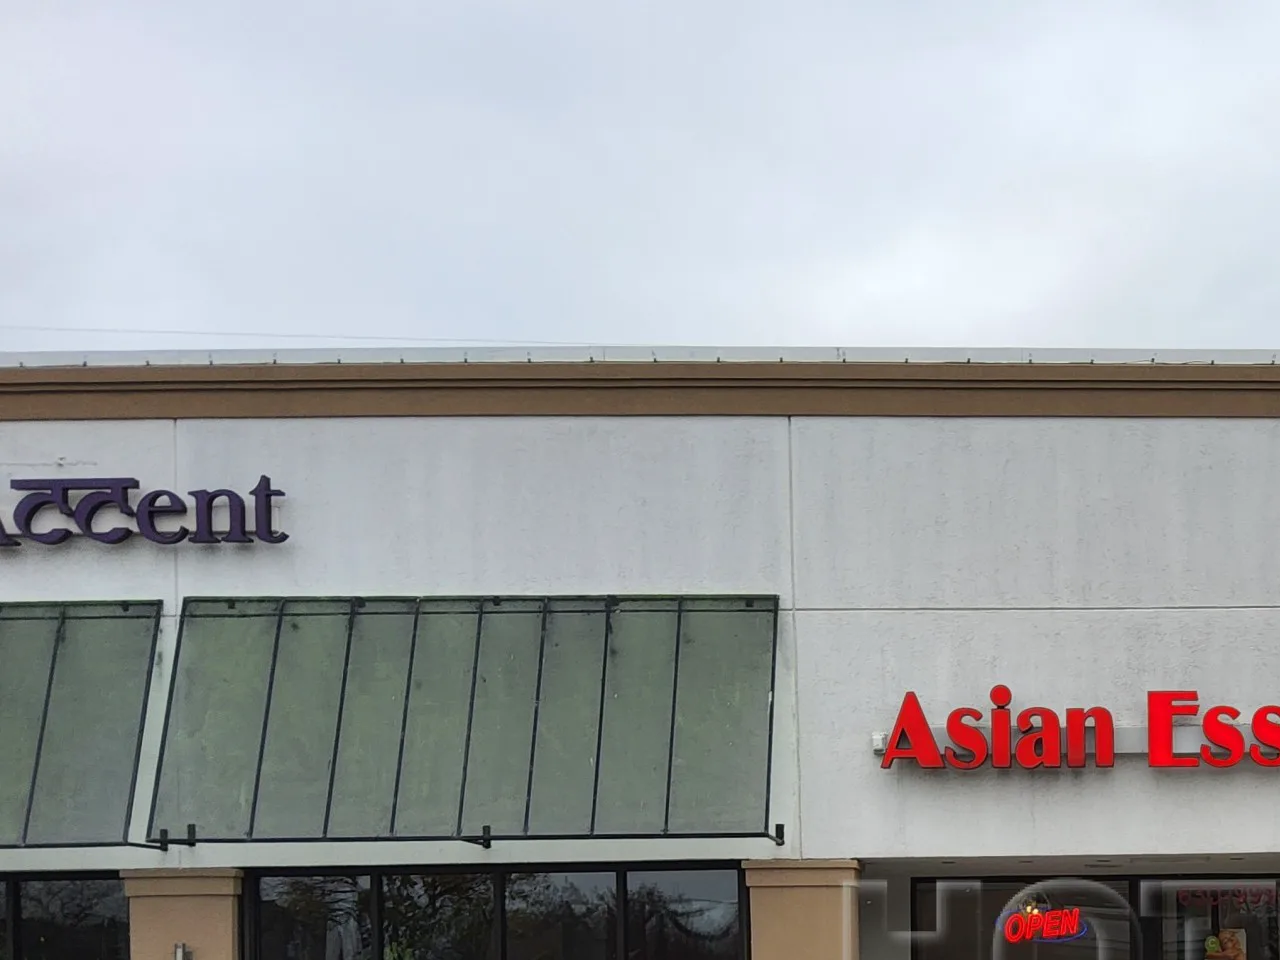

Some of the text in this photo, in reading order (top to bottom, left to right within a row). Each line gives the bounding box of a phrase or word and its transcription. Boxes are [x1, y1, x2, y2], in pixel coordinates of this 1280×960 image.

[0, 475, 289, 546] ccent
[880, 684, 1115, 770] Asian
[1004, 907, 1080, 943] OPEN
